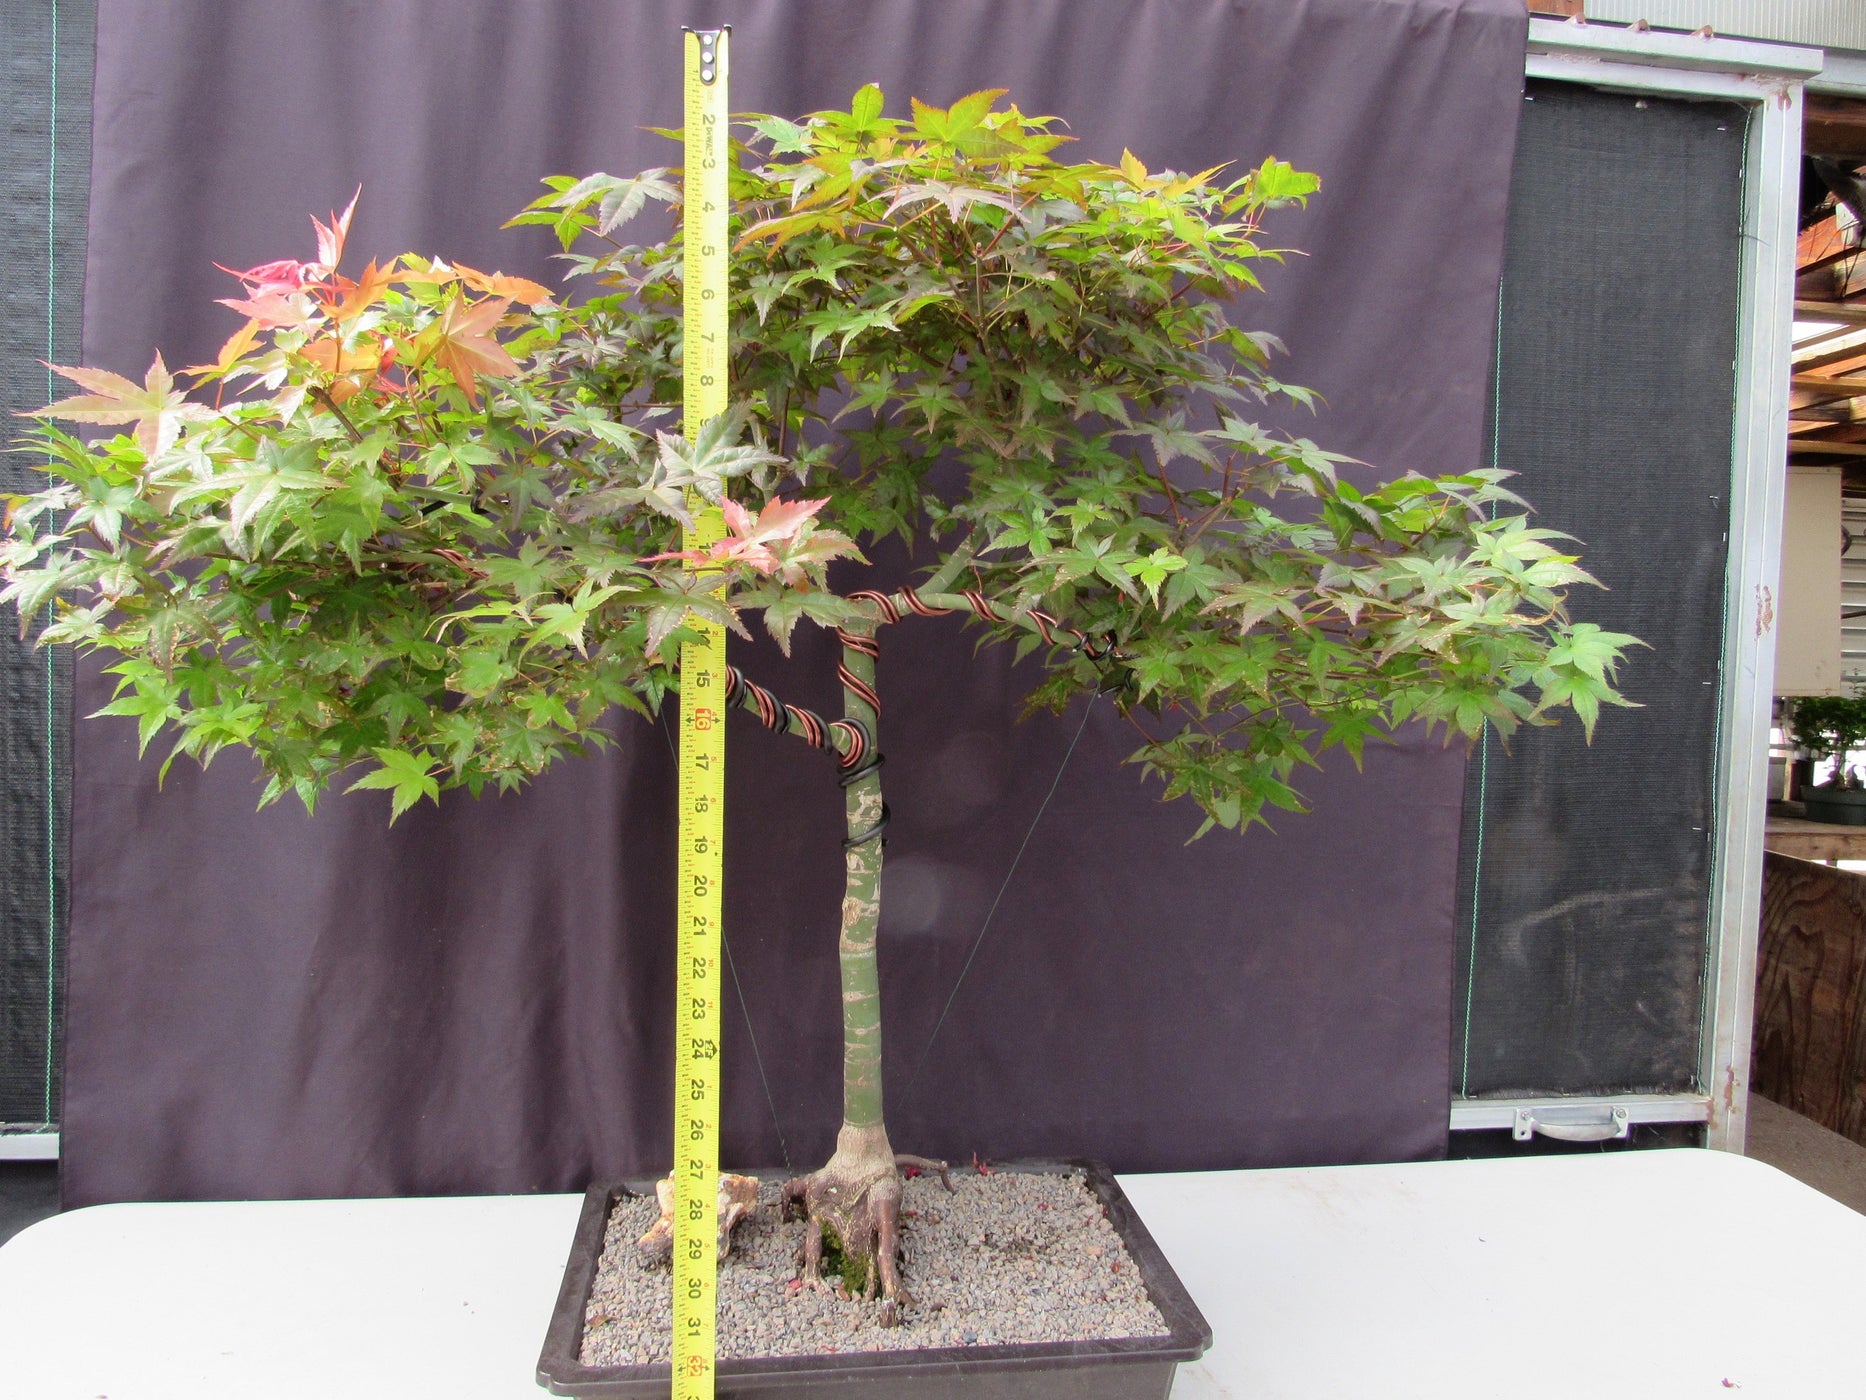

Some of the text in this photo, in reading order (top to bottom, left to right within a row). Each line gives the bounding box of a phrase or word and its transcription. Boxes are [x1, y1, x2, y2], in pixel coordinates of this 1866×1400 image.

[702, 114, 716, 125] 2
[702, 158, 716, 169] 3
[702, 201, 716, 213] 4
[701, 245, 715, 256] 5
[701, 289, 715, 300] 6
[701, 333, 714, 343] 7
[700, 375, 714, 386] 8
[696, 669, 710, 688] 15
[696, 709, 711, 729] 16
[695, 753, 709, 771] 17
[695, 794, 709, 813] 18
[694, 835, 708, 854] 19
[694, 875, 708, 897] 20
[693, 916, 707, 936] 21
[693, 957, 706, 979] 22
[692, 998, 706, 1020] 23
[692, 1038, 704, 1060] 24
[691, 1079, 704, 1101] 25
[690, 1119, 704, 1141] 26
[690, 1159, 703, 1180] 27
[689, 1199, 703, 1221] 28
[688, 1238, 702, 1260] 29
[688, 1278, 701, 1299] 30
[687, 1317, 701, 1337] 31
[687, 1356, 702, 1376] 32
